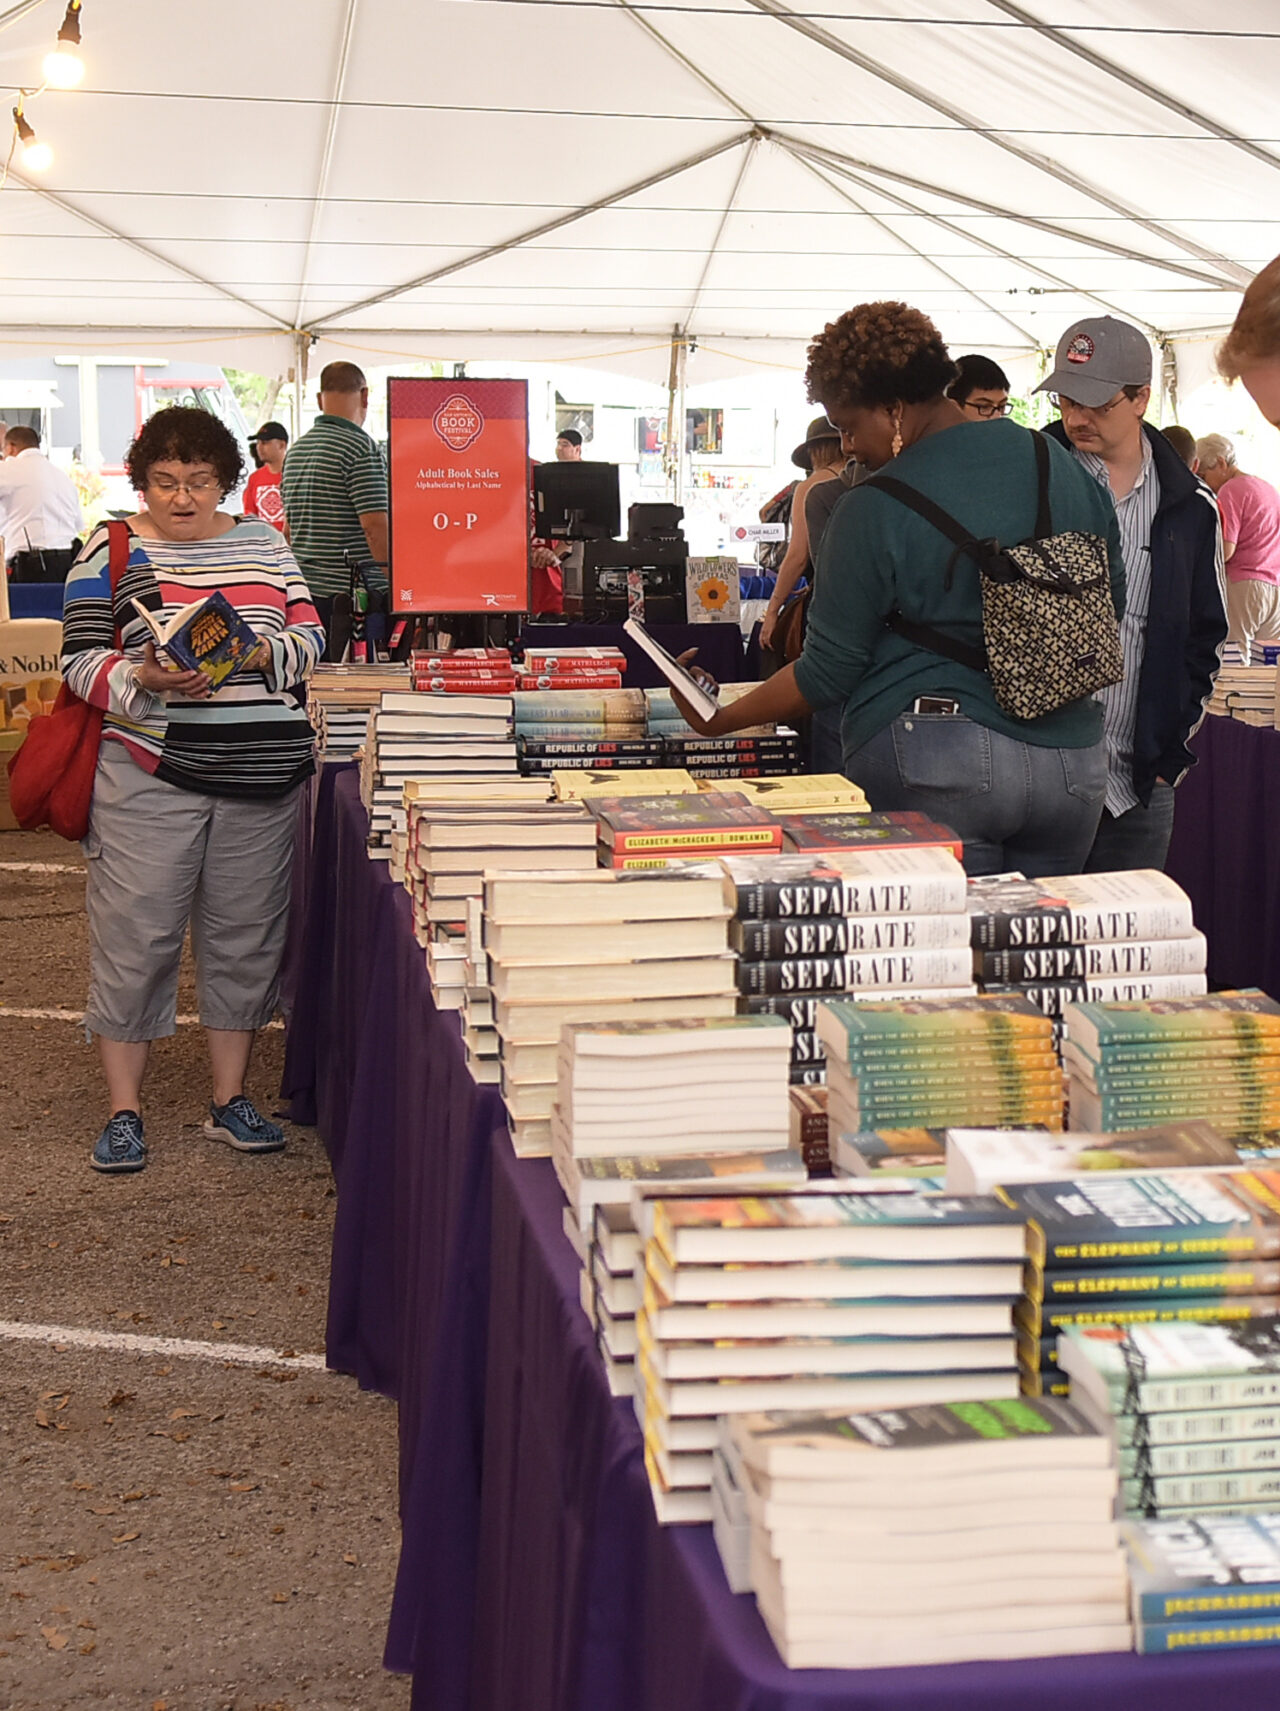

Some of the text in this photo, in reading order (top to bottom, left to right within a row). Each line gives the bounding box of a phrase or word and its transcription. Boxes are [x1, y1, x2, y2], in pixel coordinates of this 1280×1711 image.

[441, 417, 476, 427] BOOK
[417, 468, 499, 479] Adult Book Sales
[414, 481, 502, 491] Alphabetical by Last Name
[433, 512, 449, 530] O
[465, 513, 478, 530] P
[706, 572, 729, 580] TEXAS
[191, 615, 226, 650] PLANET
[194, 627, 230, 658] EARTH
[12, 654, 59, 673] Nobl
[545, 744, 586, 753] REPUBLIC
[586, 744, 598, 752] OF
[598, 743, 617, 753] LIES
[684, 741, 724, 751] REPUBLIC
[724, 741, 735, 750] OF
[735, 740, 754, 749] LIES
[541, 758, 613, 768] REPUBLIC OF LIES
[686, 753, 756, 764] REPUBLIC OF LIES
[628, 833, 769, 847] ELIZABETH McCRACKEN BOWLAWAY
[778, 884, 913, 917] SEPARATE
[1009, 911, 1138, 946] SEPARATE
[784, 921, 916, 955] SEPARATE
[1024, 947, 1152, 979] SEPARATE
[780, 956, 914, 991] SEPARATE
